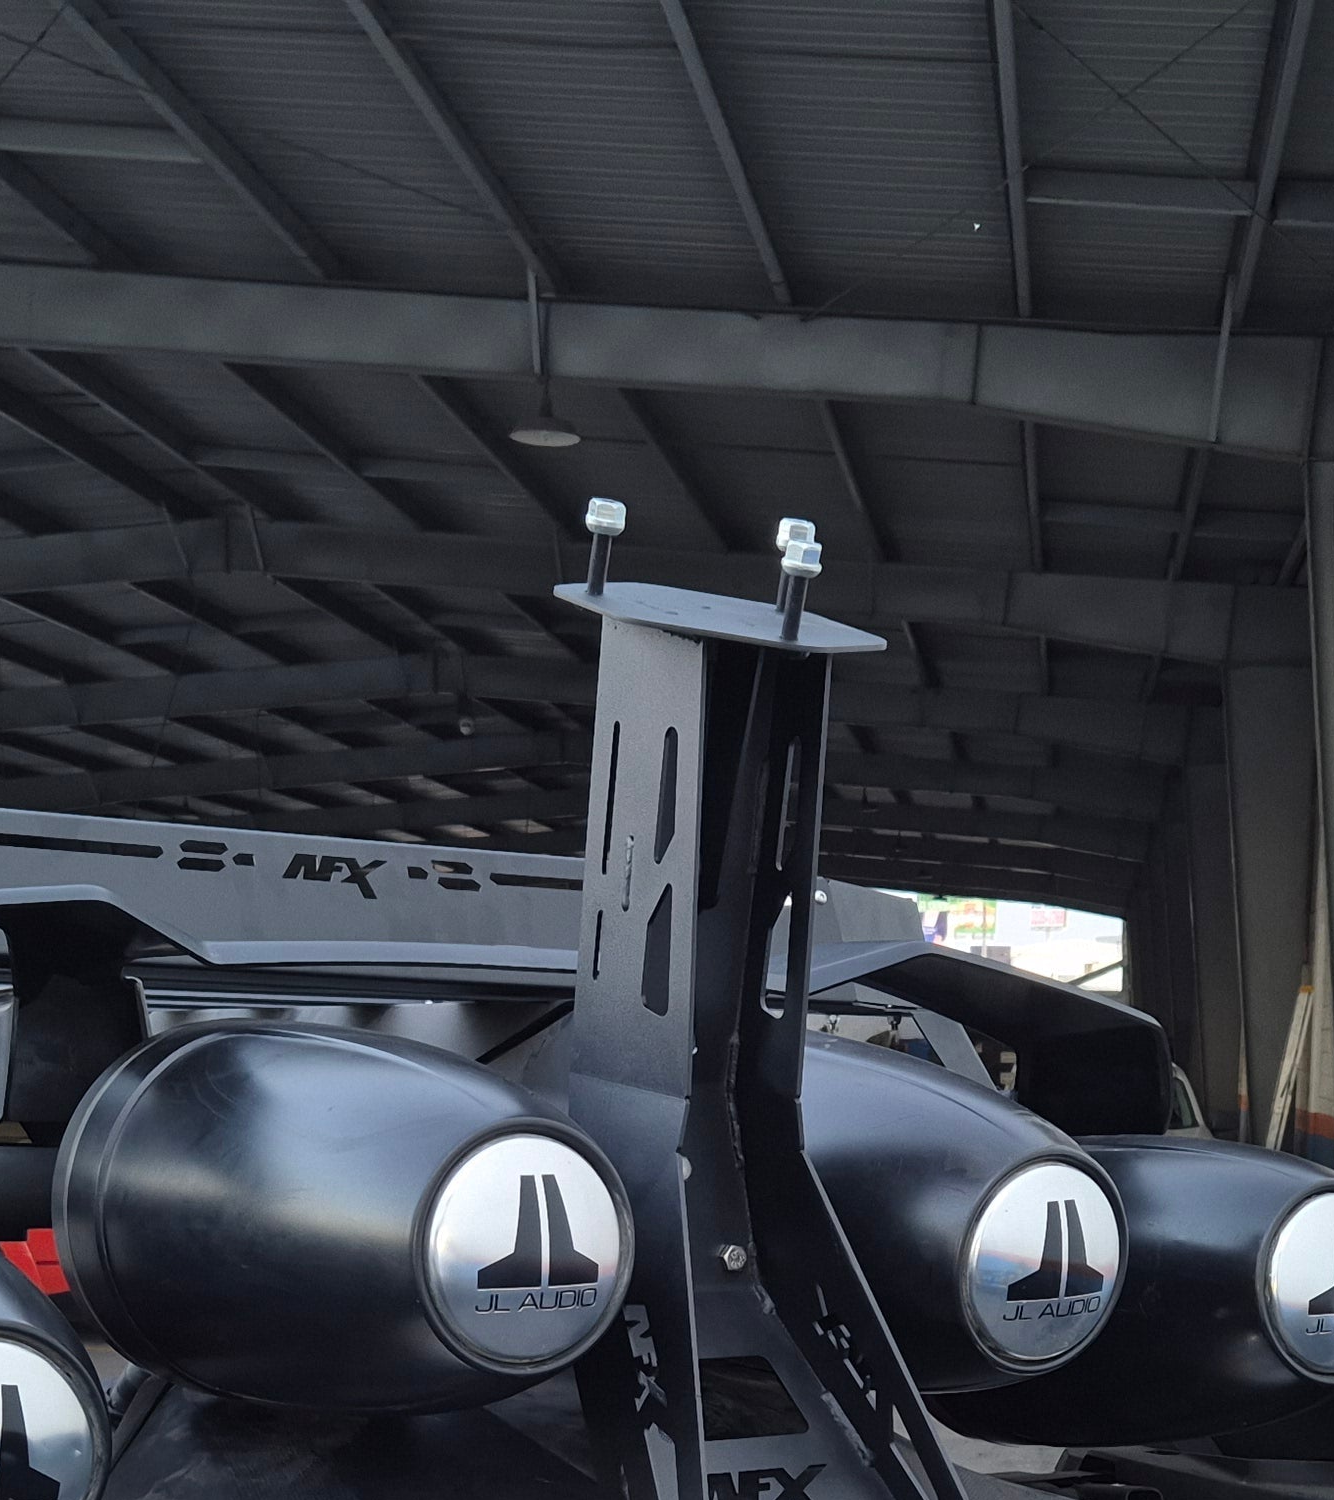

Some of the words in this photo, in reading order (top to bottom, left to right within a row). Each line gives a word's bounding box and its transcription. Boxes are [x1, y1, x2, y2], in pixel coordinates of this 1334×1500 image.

[475, 1293, 510, 1313] JL
[518, 1288, 597, 1311] AUDIO
[1002, 1304, 1032, 1321] JL
[1038, 1295, 1101, 1319] AUDIO
[1305, 1318, 1332, 1334] JL
